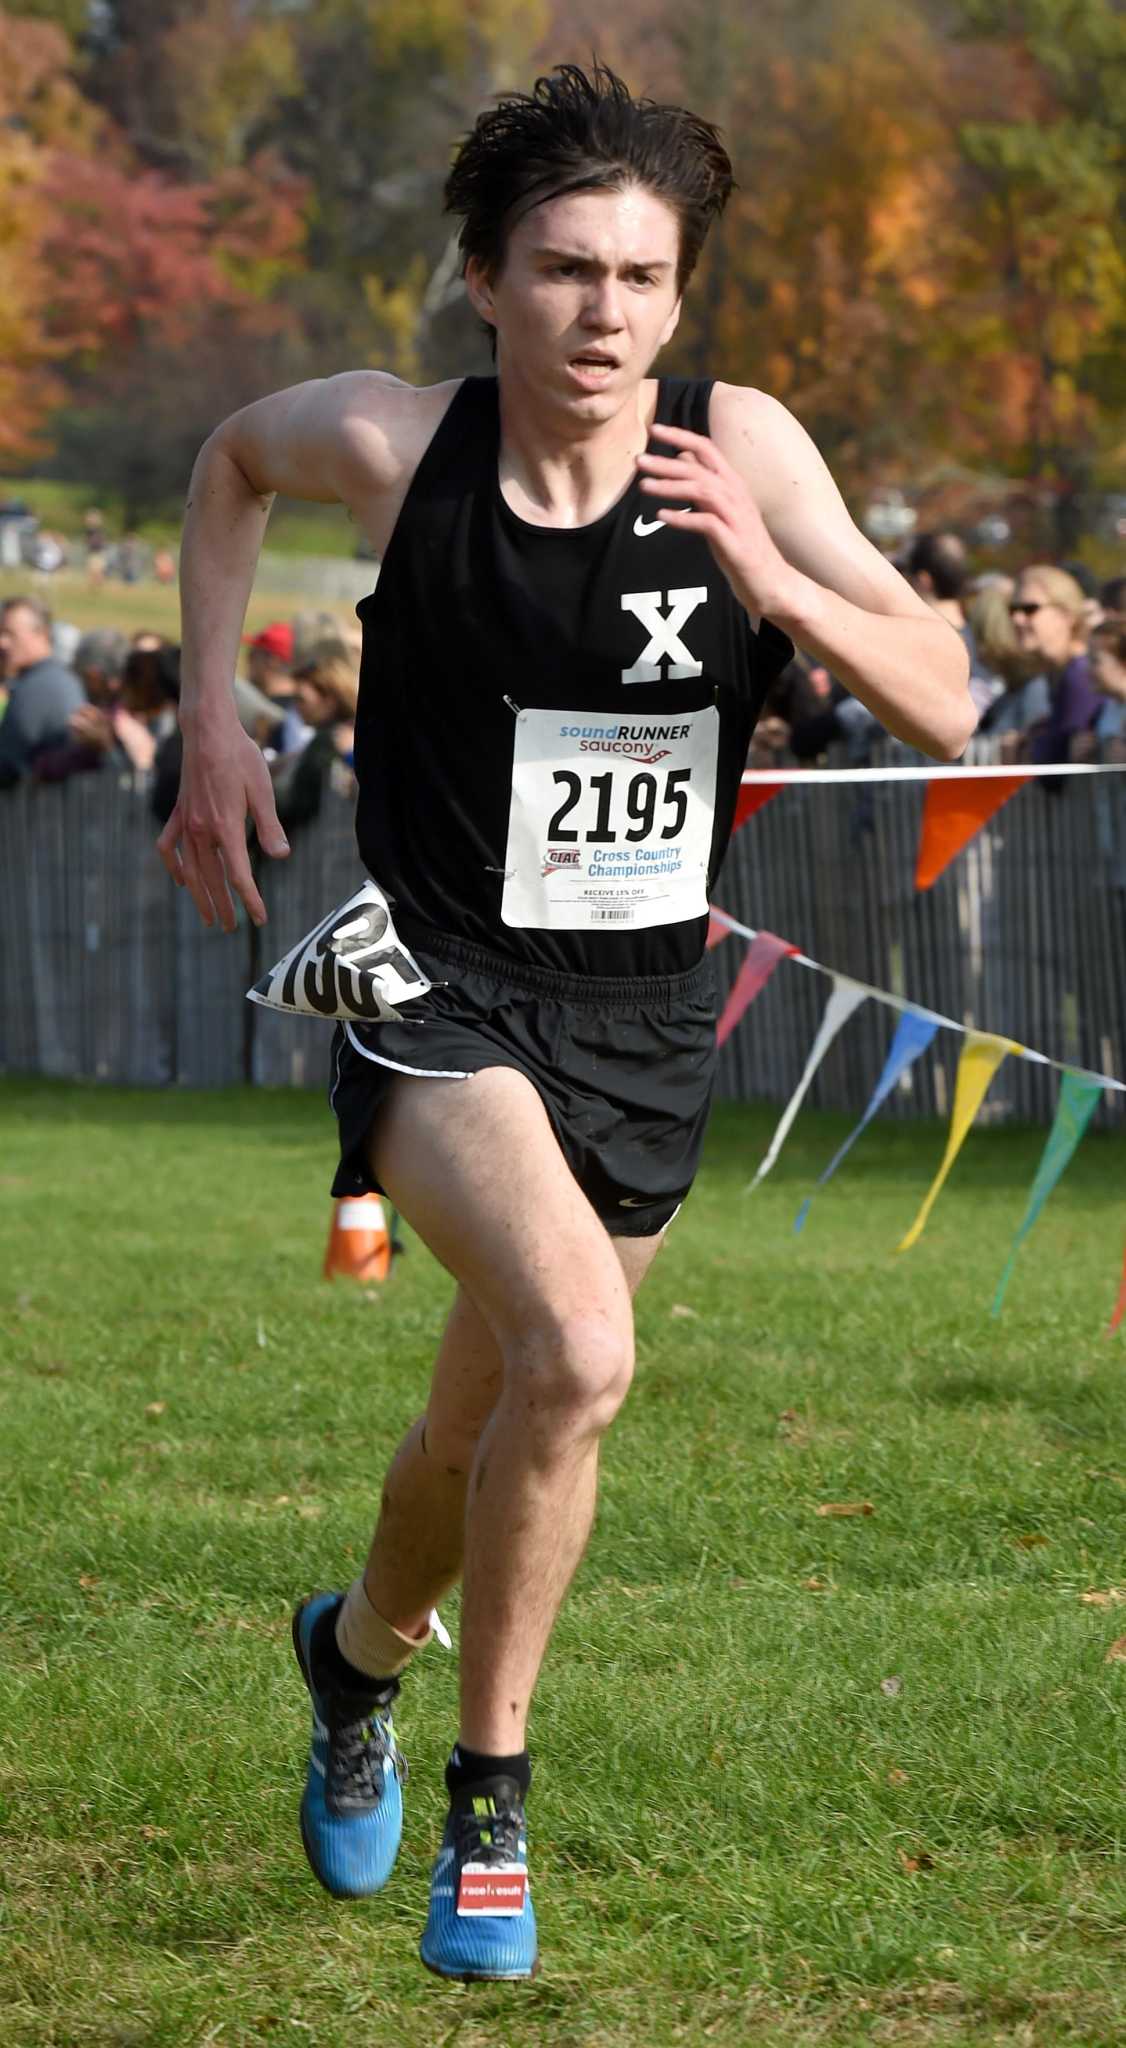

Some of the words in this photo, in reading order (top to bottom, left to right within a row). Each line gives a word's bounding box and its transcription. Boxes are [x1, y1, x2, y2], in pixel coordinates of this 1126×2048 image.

[621, 586, 708, 684] X
[559, 725, 691, 741] soundRUNNER
[579, 740, 654, 756] saucony
[547, 768, 692, 843] 2195
[593, 849, 631, 862] Cross
[635, 847, 682, 861] Country
[587, 860, 683, 878] Championships
